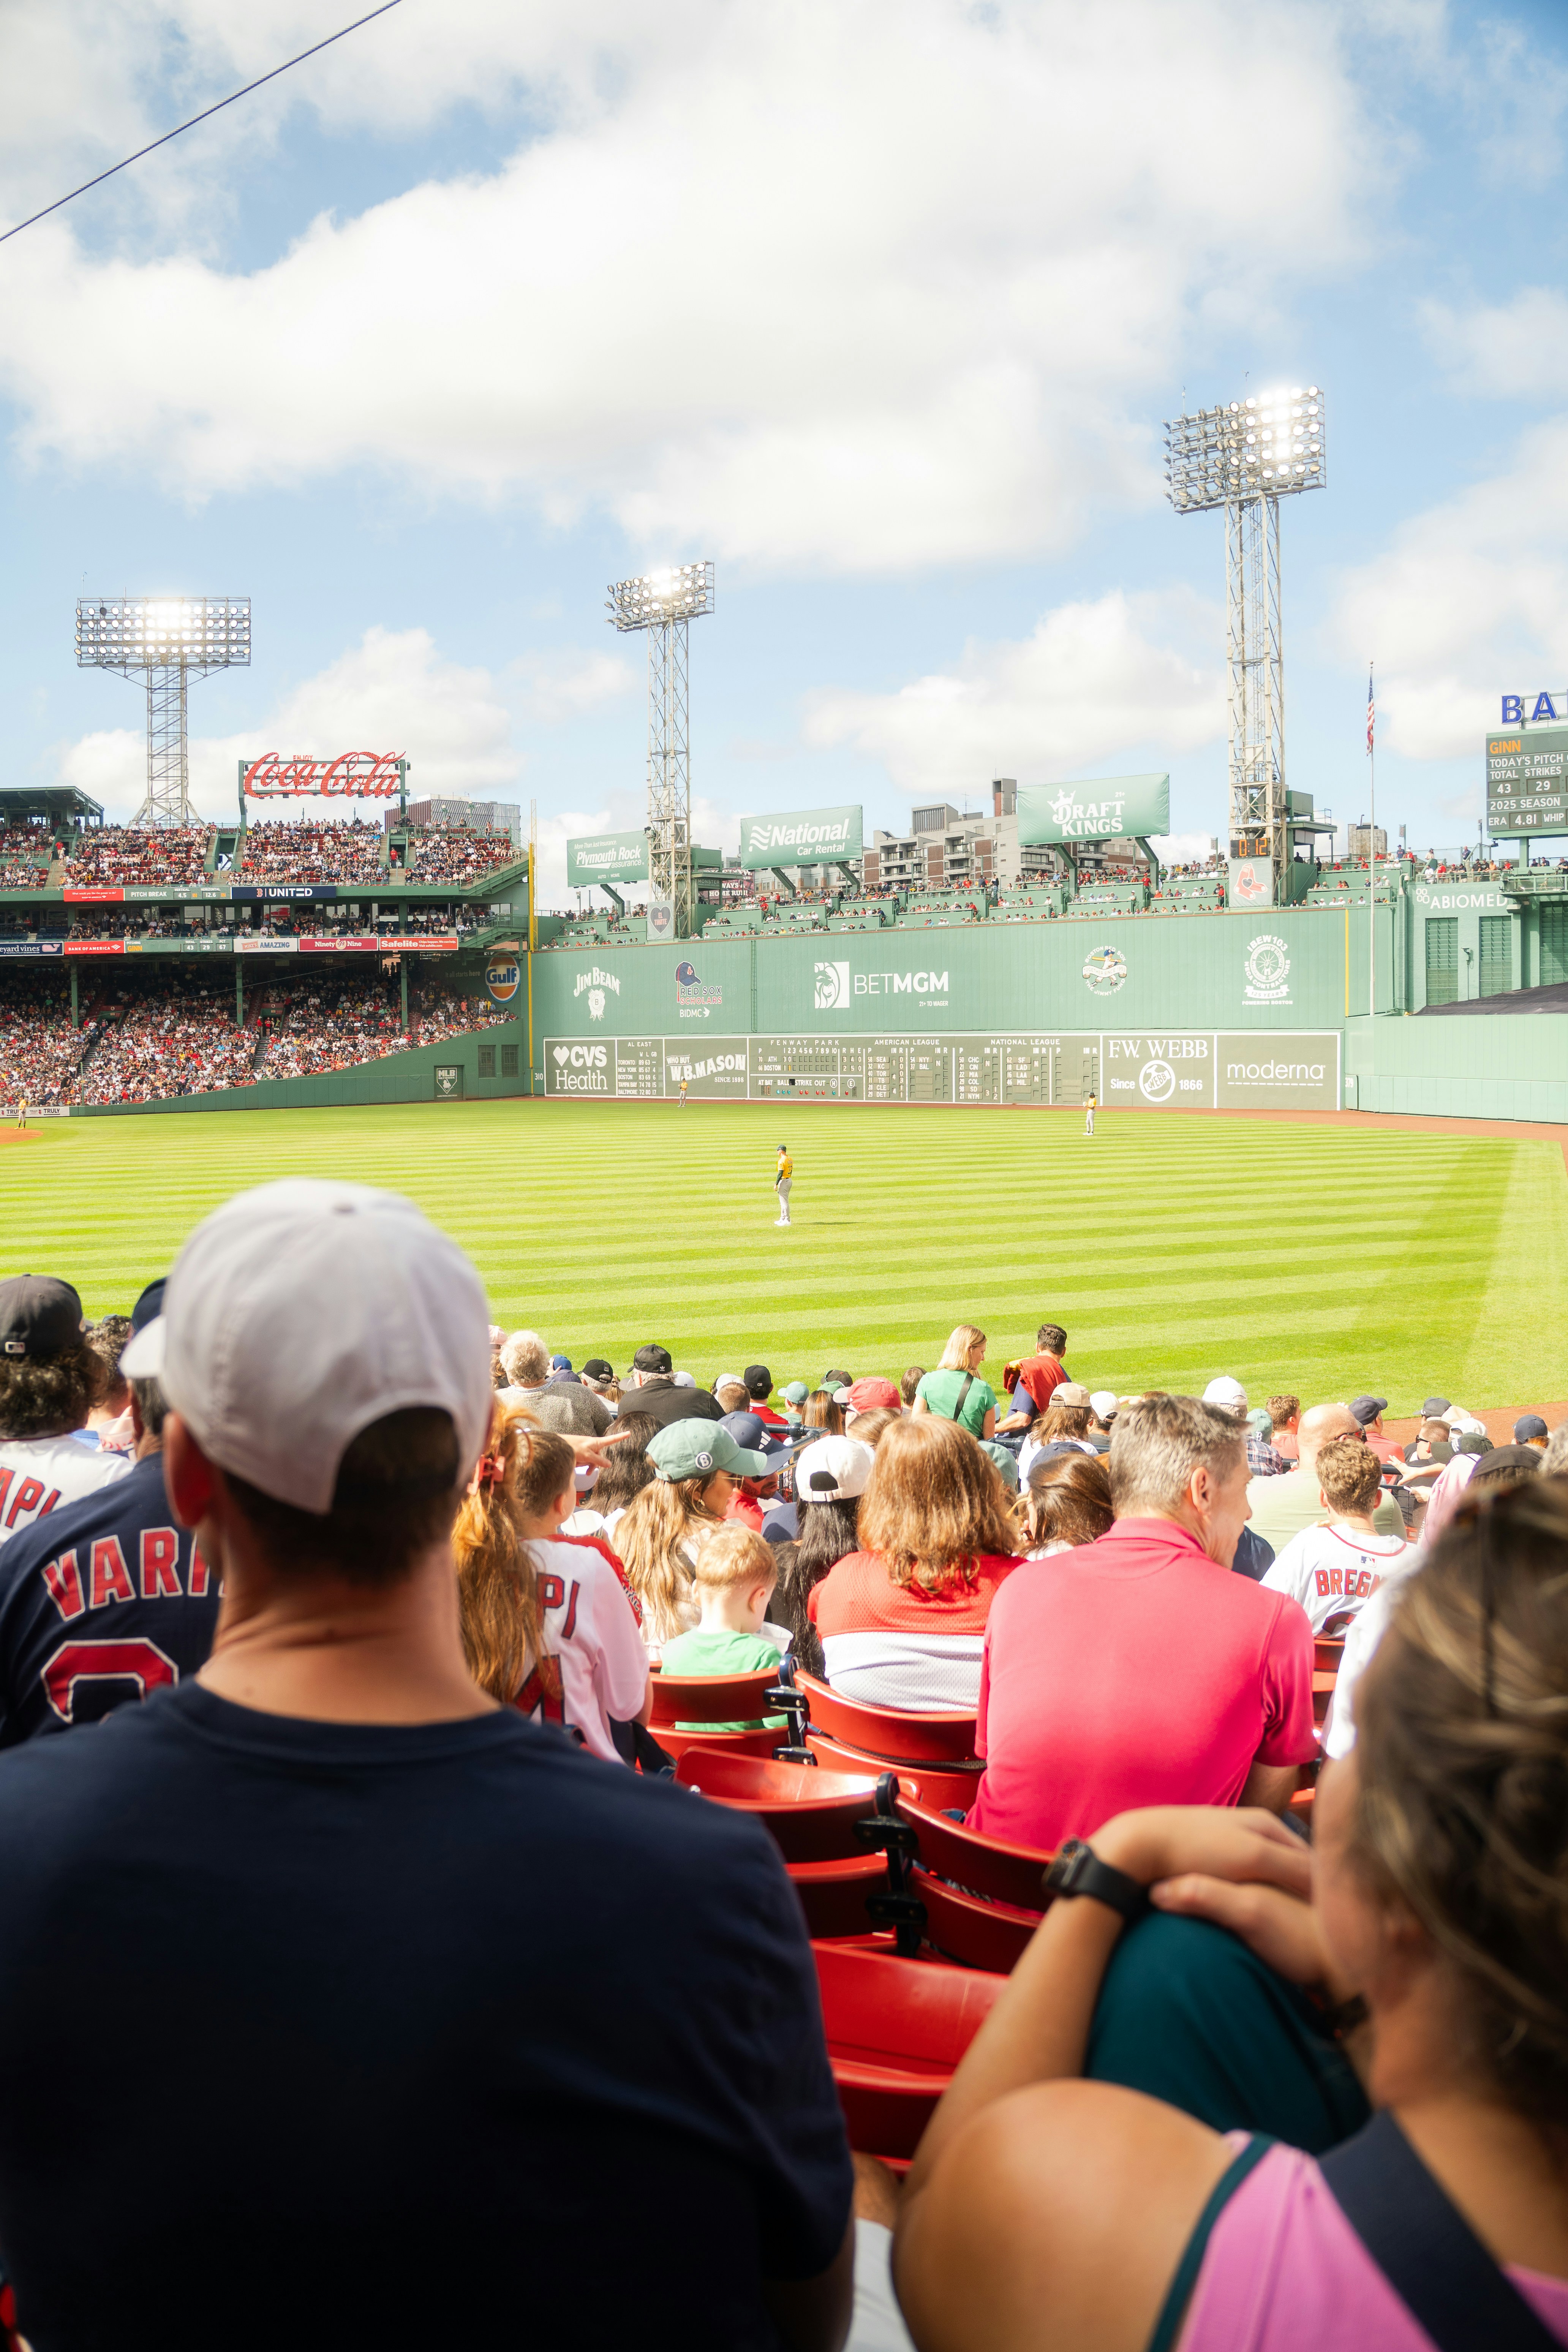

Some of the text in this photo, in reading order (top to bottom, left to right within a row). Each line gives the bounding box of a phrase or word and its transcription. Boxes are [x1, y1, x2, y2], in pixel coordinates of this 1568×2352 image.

[1502, 689, 1568, 724] BA
[1490, 740, 1521, 754] GINN
[1489, 756, 1530, 768] TODAY'S
[1534, 754, 1563, 765] PITCH
[1490, 767, 1562, 779] TOTAL STRIKES
[1497, 780, 1551, 794] 43 29
[1490, 797, 1560, 811] 2025 SEASON
[1053, 801, 1125, 824] DRAFT
[1488, 813, 1565, 826] ERA 4.81 WHIP
[770, 818, 850, 847] National
[1062, 817, 1123, 836] KINGS
[576, 845, 641, 866] Plymouth Rock
[797, 842, 845, 856] Car Rental
[1239, 838, 1267, 857] 0:12
[611, 859, 642, 868] assurance
[269, 888, 313, 897] UNITED
[1430, 894, 1508, 909] ABIOMED
[1247, 935, 1288, 952] IBEW 103
[1085, 946, 1104, 963] BOSTON
[1117, 951, 1126, 962] SOX
[486, 967, 517, 984] Gulf
[574, 967, 620, 997] JIM BEAM
[1244, 961, 1253, 981] NECA
[1252, 959, 1290, 989] CONTRACTORS
[854, 971, 948, 994] BETMGM
[1085, 980, 1094, 991] THE
[1113, 978, 1125, 993] FUND
[680, 986, 722, 996] RED SOX
[680, 996, 722, 1005] SCHOLARS
[680, 1008, 702, 1018] BIDMC
[570, 1046, 607, 1067] CVS
[1108, 1040, 1208, 1058] F.W. WEBB
[1227, 1059, 1323, 1080] moderna
[555, 1070, 608, 1090] Health
[1110, 1078, 1203, 1091] Since 1866
[1148, 1073, 1166, 1089] WEBB
[700, 1454, 709, 1467] B
[41, 1526, 227, 1622] VARI
